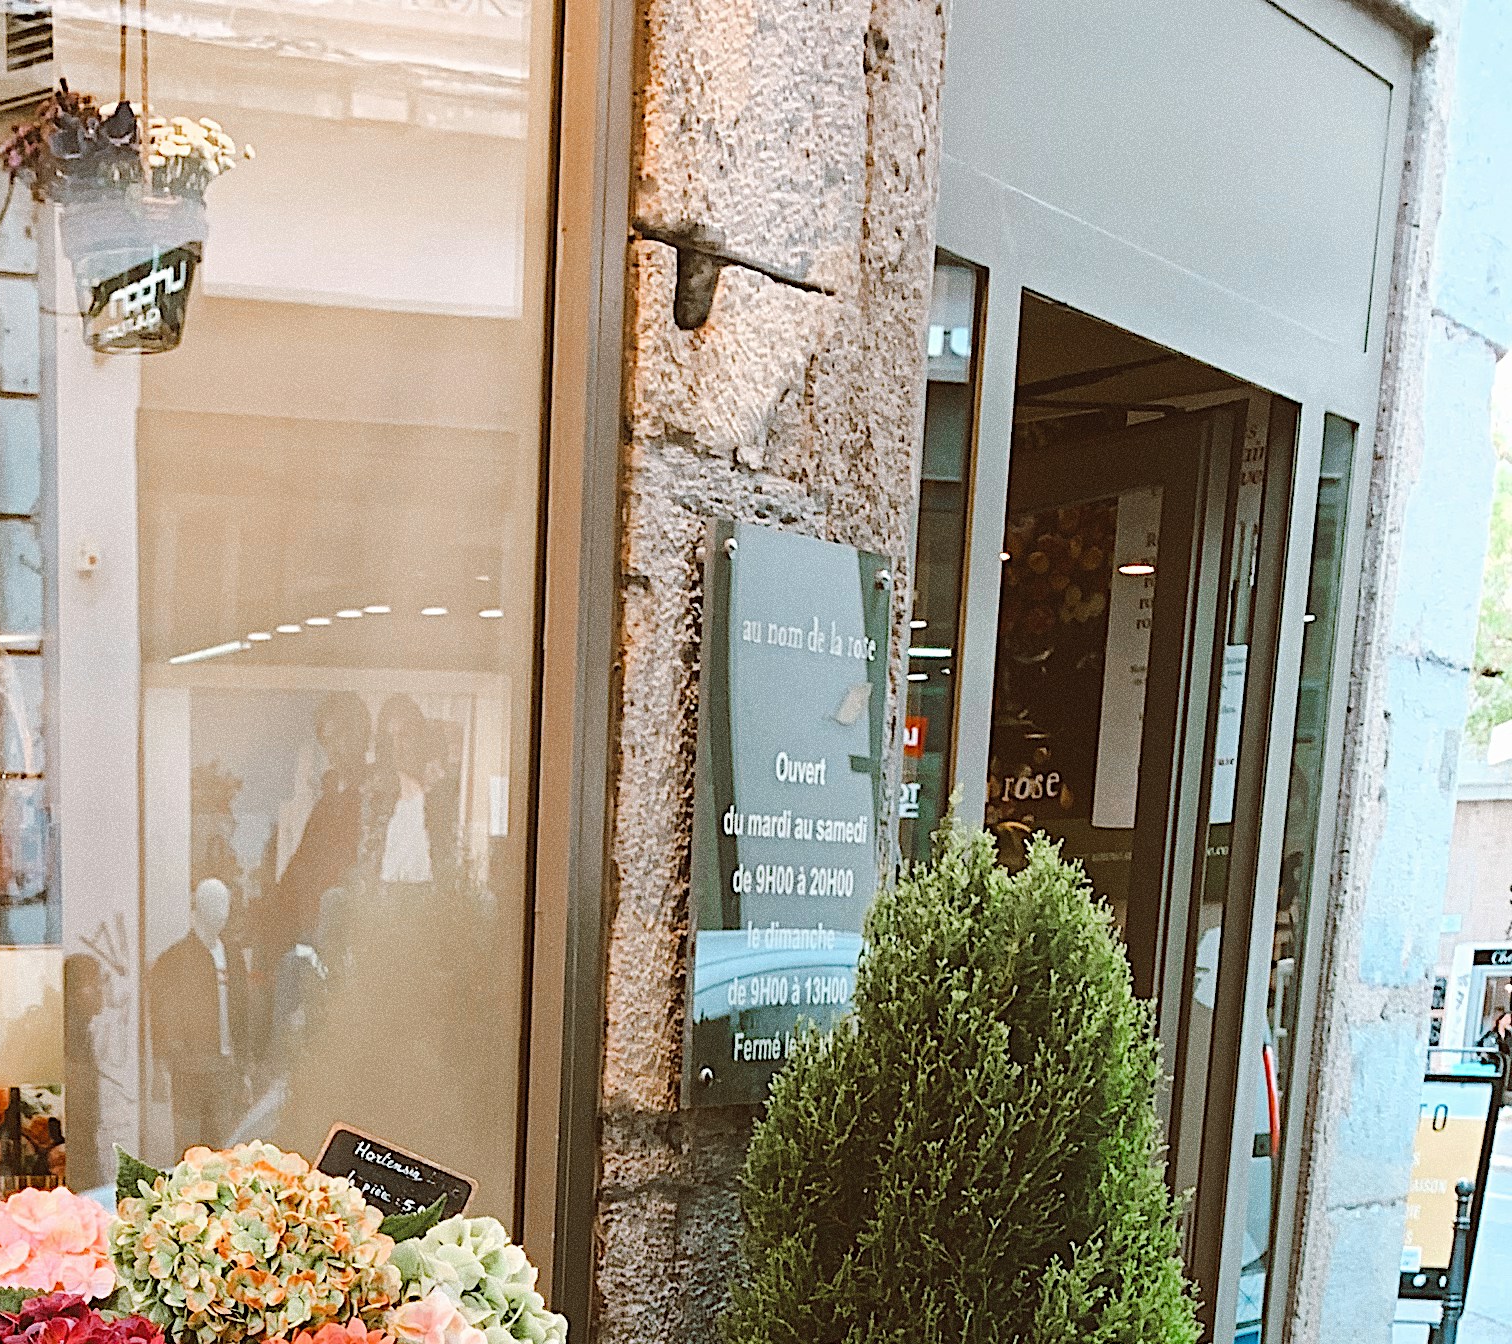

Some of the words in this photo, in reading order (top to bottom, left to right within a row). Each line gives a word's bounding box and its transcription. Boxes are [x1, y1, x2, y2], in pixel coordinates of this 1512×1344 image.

[743, 620, 762, 643] au
[767, 622, 803, 649] nom
[807, 616, 825, 653] de
[829, 620, 843, 657] la
[847, 635, 877, 661] rose
[776, 752, 826, 786] Ouvert
[1002, 771, 1060, 803] rose
[723, 805, 744, 836] du
[747, 810, 790, 840] mardi
[794, 820, 813, 841] au
[816, 815, 868, 844] samedi
[733, 865, 752, 894] de
[755, 864, 794, 895] 9H00
[797, 866, 806, 895] à
[809, 867, 854, 898] 20H00
[747, 920, 760, 948] le
[764, 921, 836, 951] dimanche
[728, 977, 747, 1006] de
[750, 976, 788, 1006] 9H00
[791, 976, 801, 1006] à
[805, 976, 847, 1006] 13H00
[733, 1030, 781, 1062] Fermé
[354, 1141, 423, 1181] Hortensia
